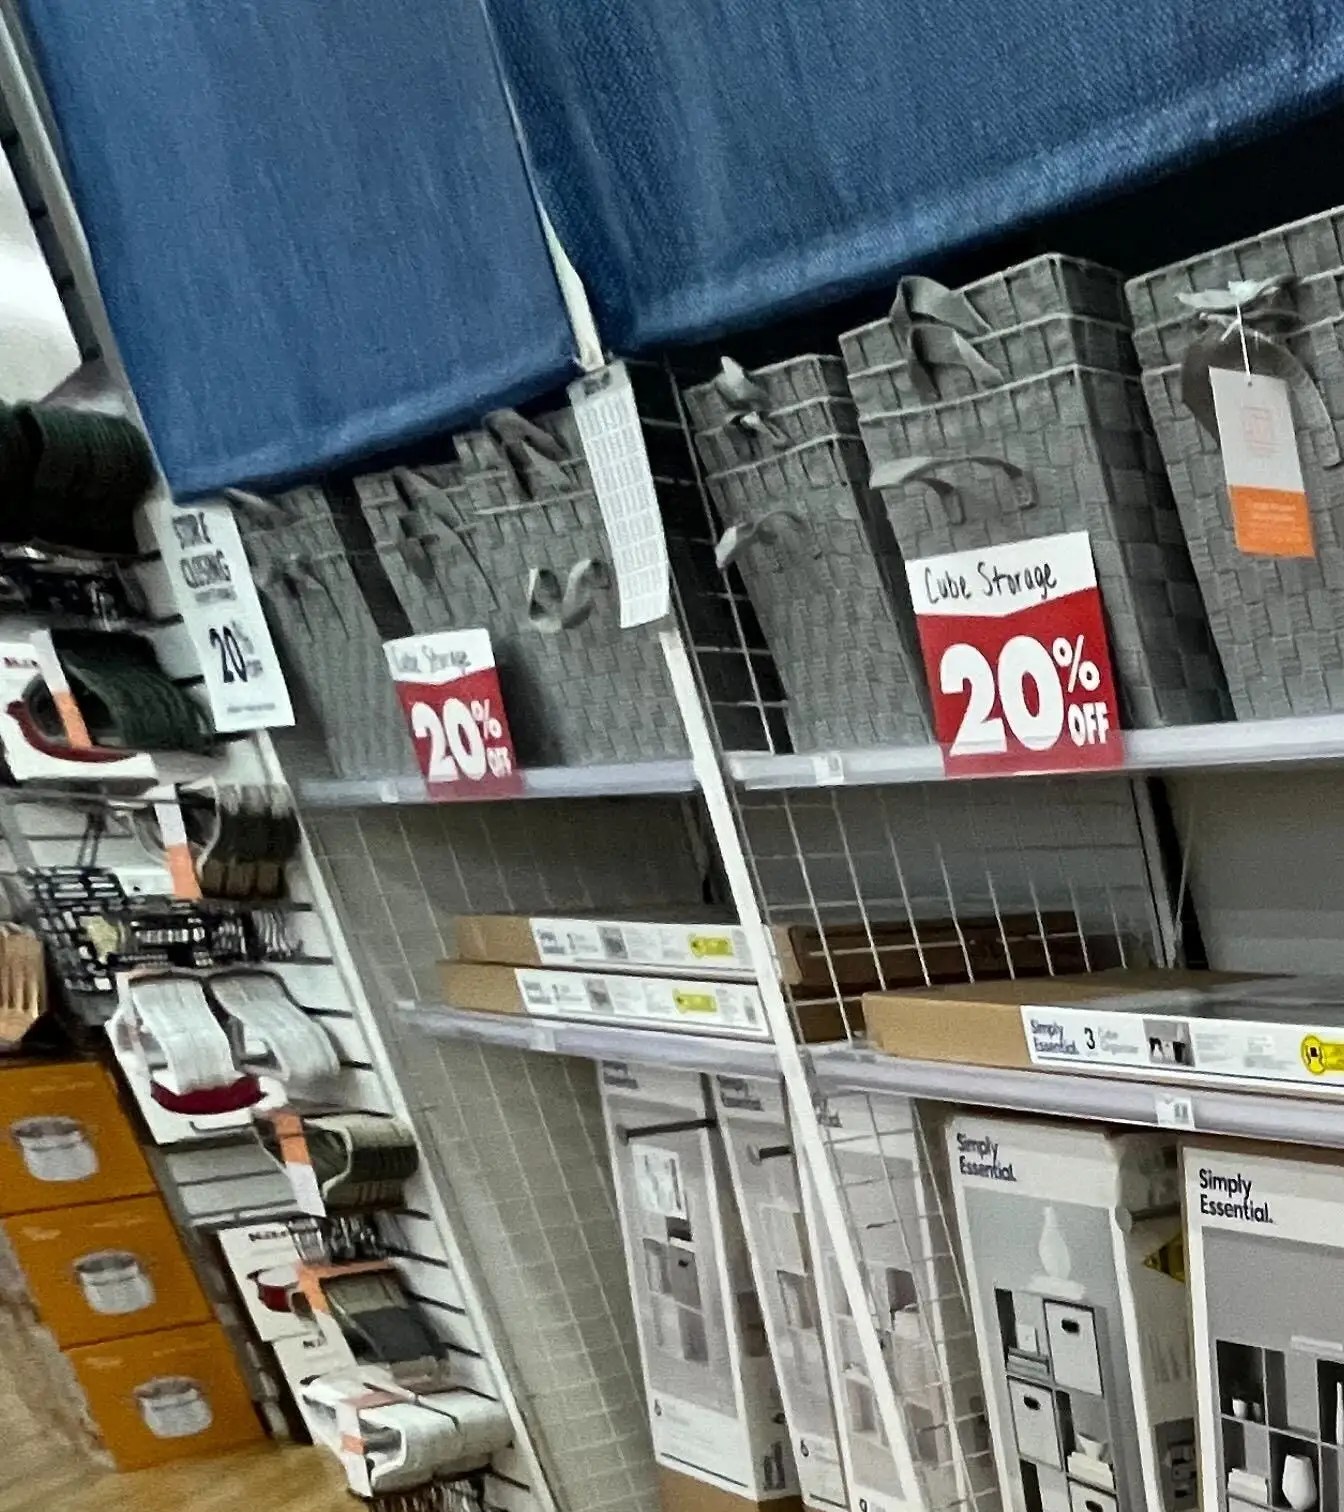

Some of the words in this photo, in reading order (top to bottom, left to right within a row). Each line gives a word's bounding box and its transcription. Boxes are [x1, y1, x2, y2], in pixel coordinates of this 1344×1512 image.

[924, 566, 971, 605] Cube
[977, 560, 1058, 600] Storage
[939, 634, 1101, 757] 20%
[411, 698, 503, 782] 20%
[1067, 701, 1110, 746] OFF
[1083, 1027, 1096, 1050] 3
[957, 1132, 999, 1160] Simply
[1199, 1168, 1253, 1201] Simply
